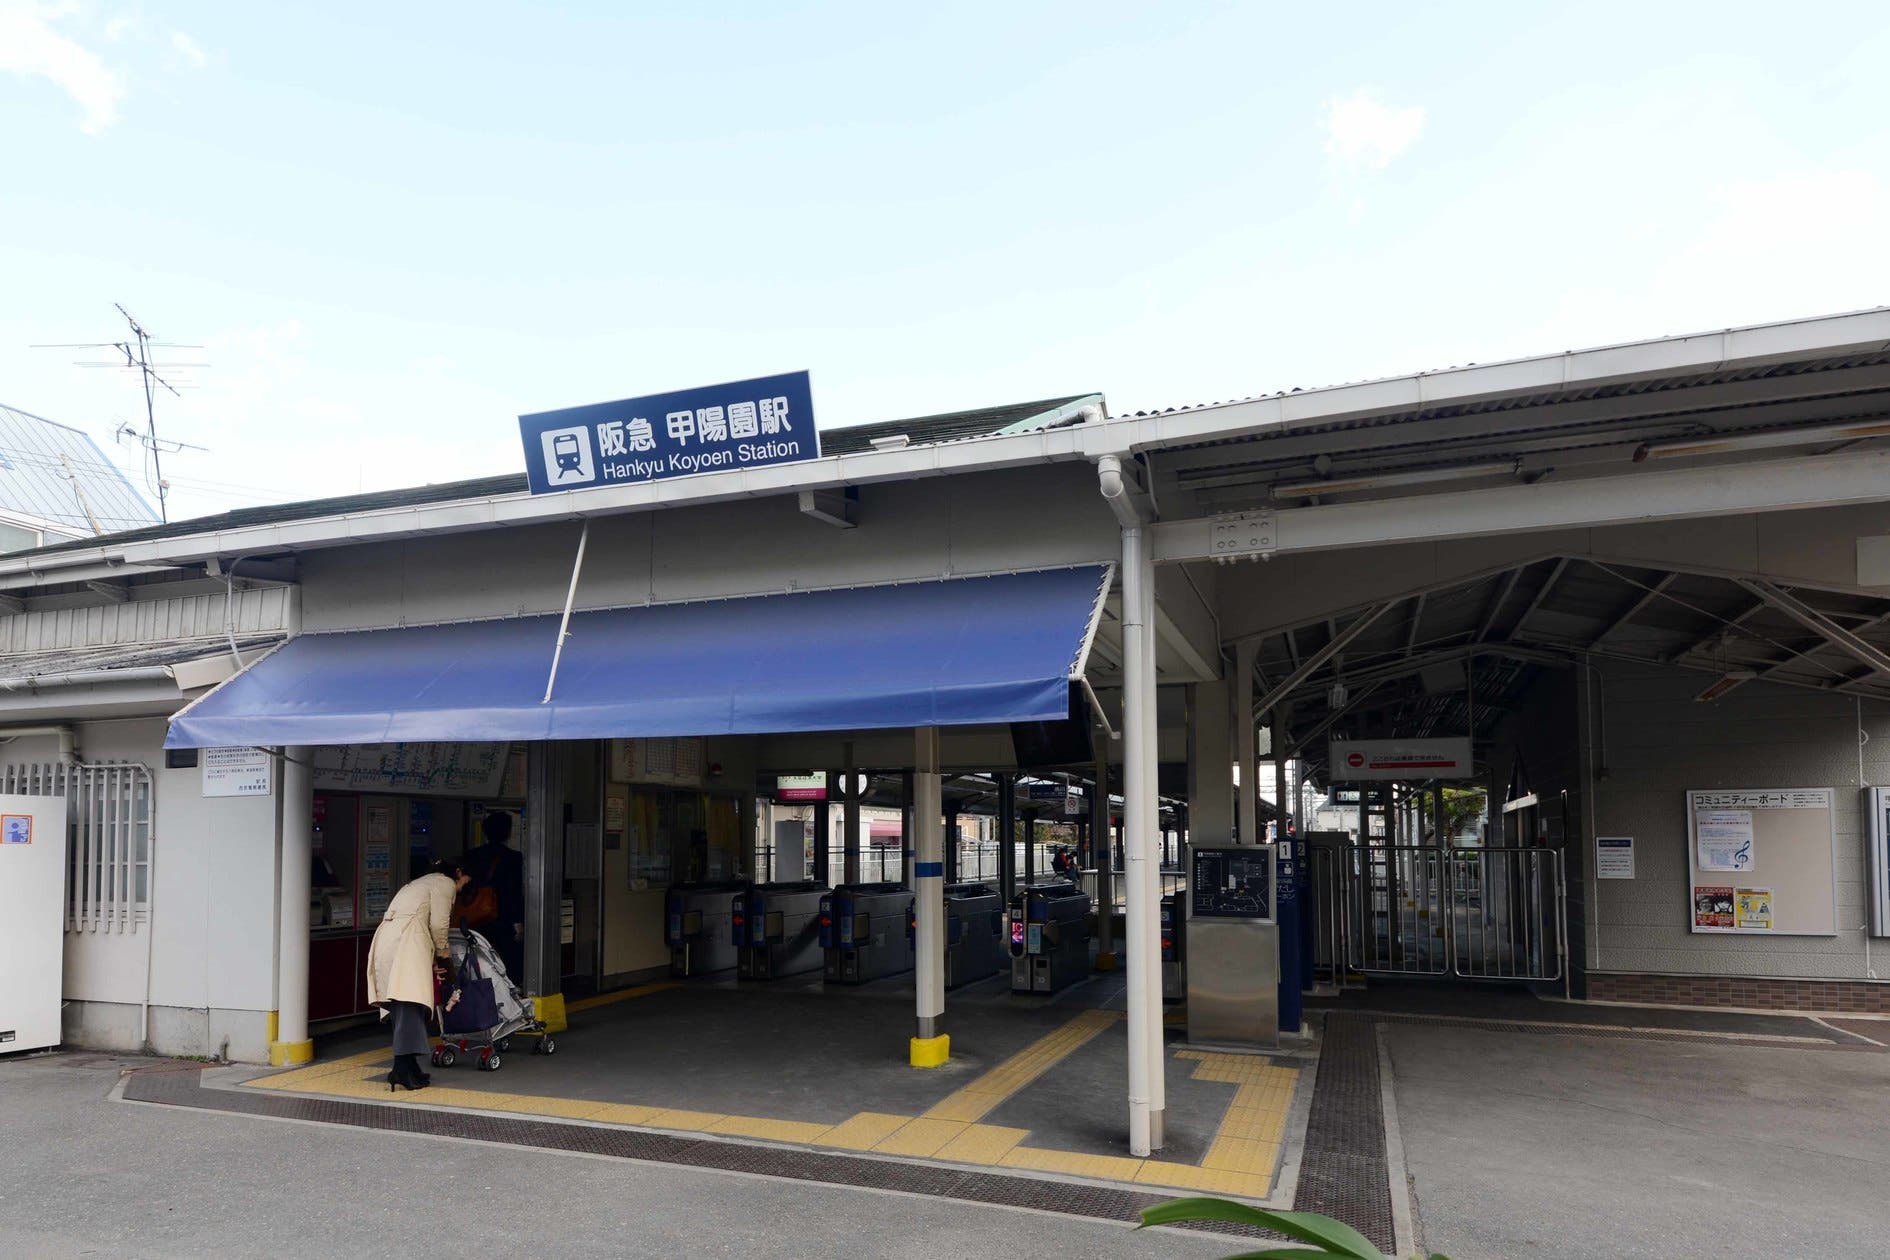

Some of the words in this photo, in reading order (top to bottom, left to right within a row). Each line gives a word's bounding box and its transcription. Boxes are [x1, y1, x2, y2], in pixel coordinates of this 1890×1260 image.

[597, 417, 657, 458] 阪急
[666, 396, 793, 447] 甲陽園駅
[603, 457, 664, 480] Hankyu
[669, 449, 733, 473] Koyoen
[738, 440, 799, 463] Station
[1695, 794, 1790, 806] コミュニティーボード
